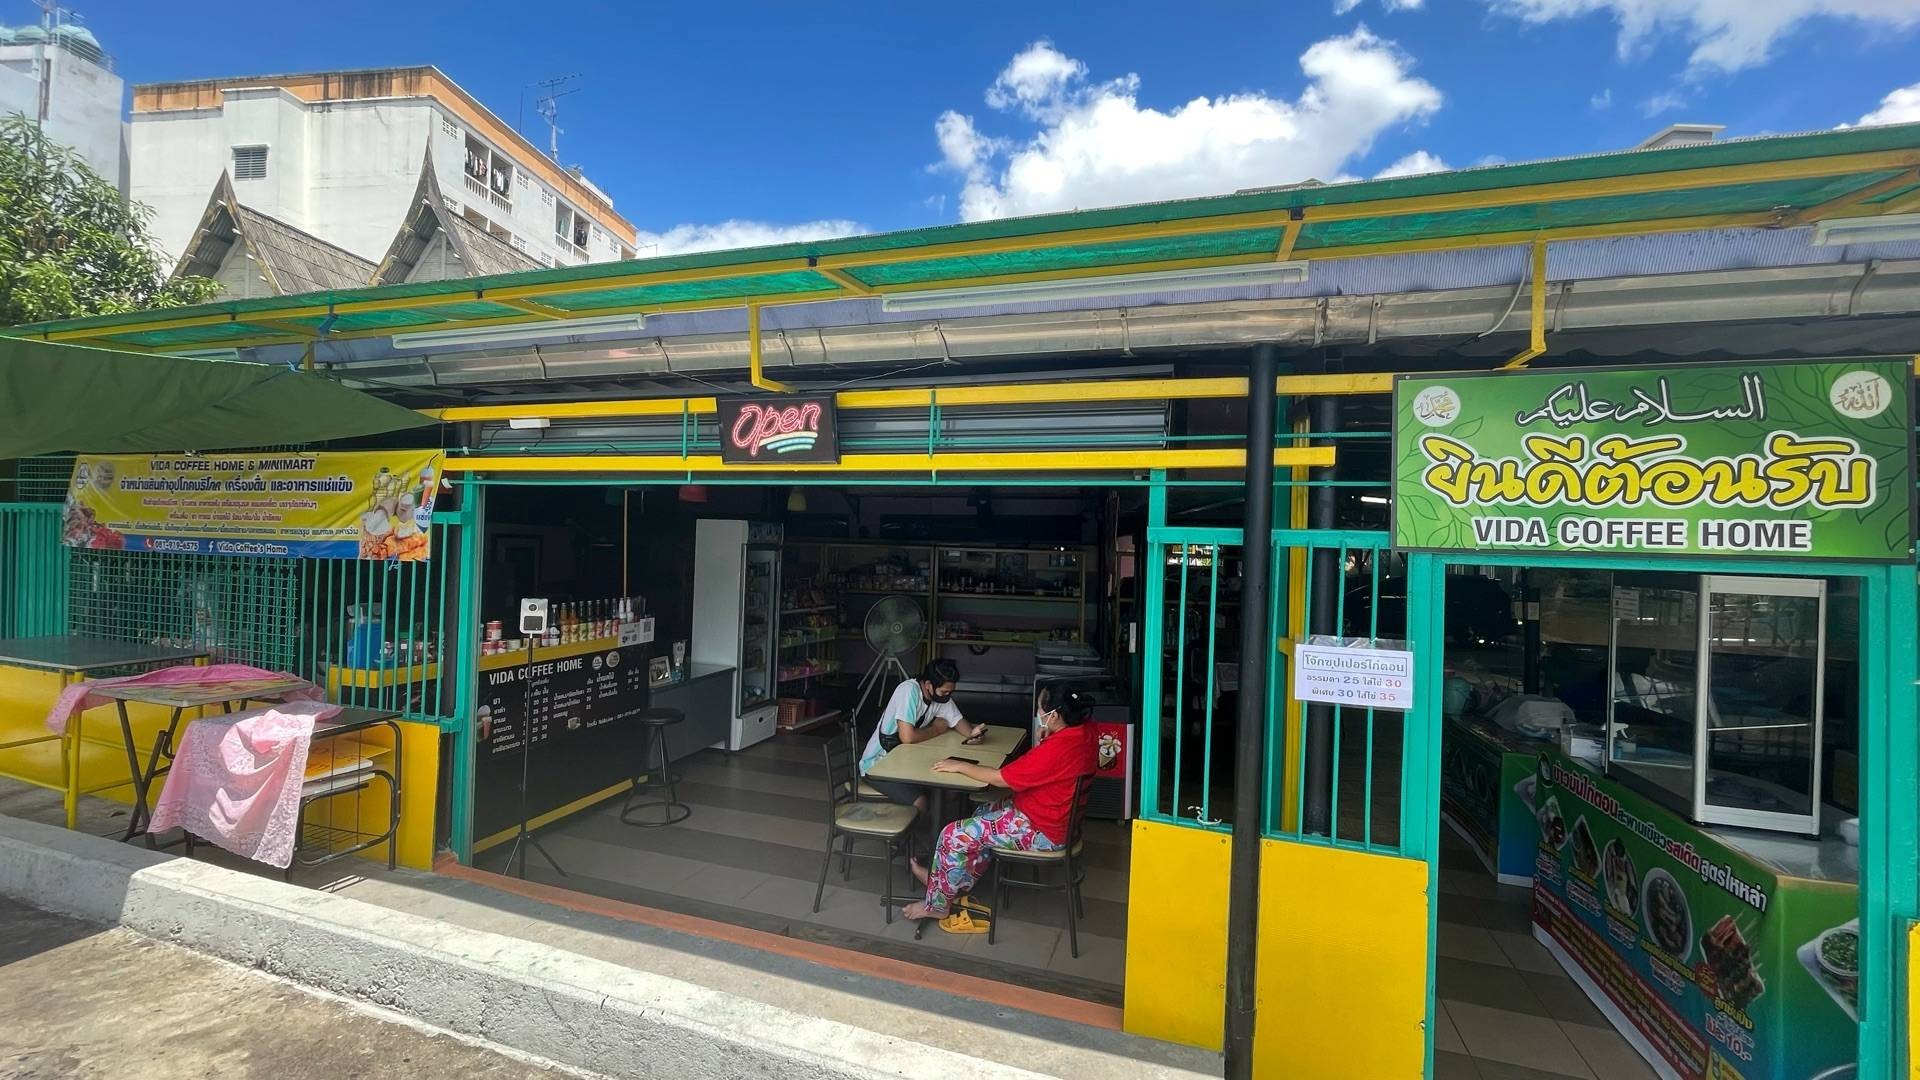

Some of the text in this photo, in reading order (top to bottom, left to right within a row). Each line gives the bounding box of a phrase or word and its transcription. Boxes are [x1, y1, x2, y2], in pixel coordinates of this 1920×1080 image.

[1518, 375, 1764, 427] السلام عليكم
[733, 404, 820, 455] Open
[151, 460, 315, 470] VIDA COFFEE HOME & MINIMART
[1422, 434, 1871, 506] ยินดีต้อนรับ
[225, 475, 266, 491] เครื่องดื่ม
[271, 476, 353, 491] และอาหารแช่แข็ง
[1475, 519, 1808, 548] VIDA COFFEE HOME
[218, 542, 287, 553] Vida Coffee's Home
[489, 670, 514, 685] VIDA
[556, 658, 583, 673] HOME
[1306, 674, 1340, 683] ธรรมดา
[1343, 676, 1360, 685] 25
[1385, 679, 1402, 688] 30
[1311, 686, 1334, 696] พิเศษ
[1337, 690, 1354, 698] 30
[1379, 692, 1396, 701] 35
